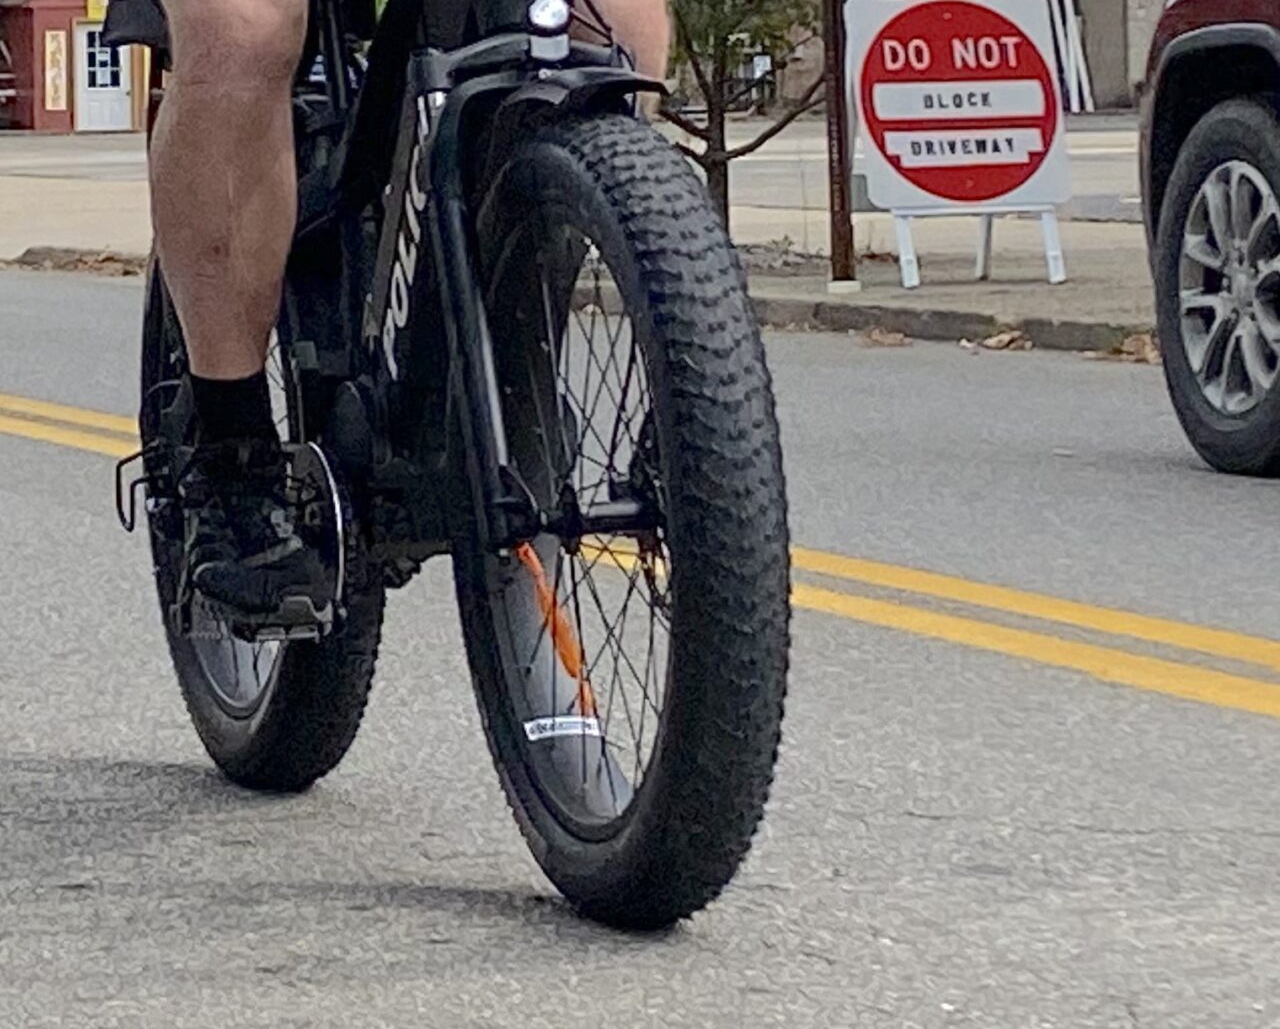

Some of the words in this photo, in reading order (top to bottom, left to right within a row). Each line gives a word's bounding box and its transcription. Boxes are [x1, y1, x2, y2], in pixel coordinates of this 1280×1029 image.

[882, 38, 931, 71] DO
[951, 36, 1022, 70] NOT
[923, 91, 992, 109] BLOCK
[910, 137, 1015, 156] DRIVEWAY
